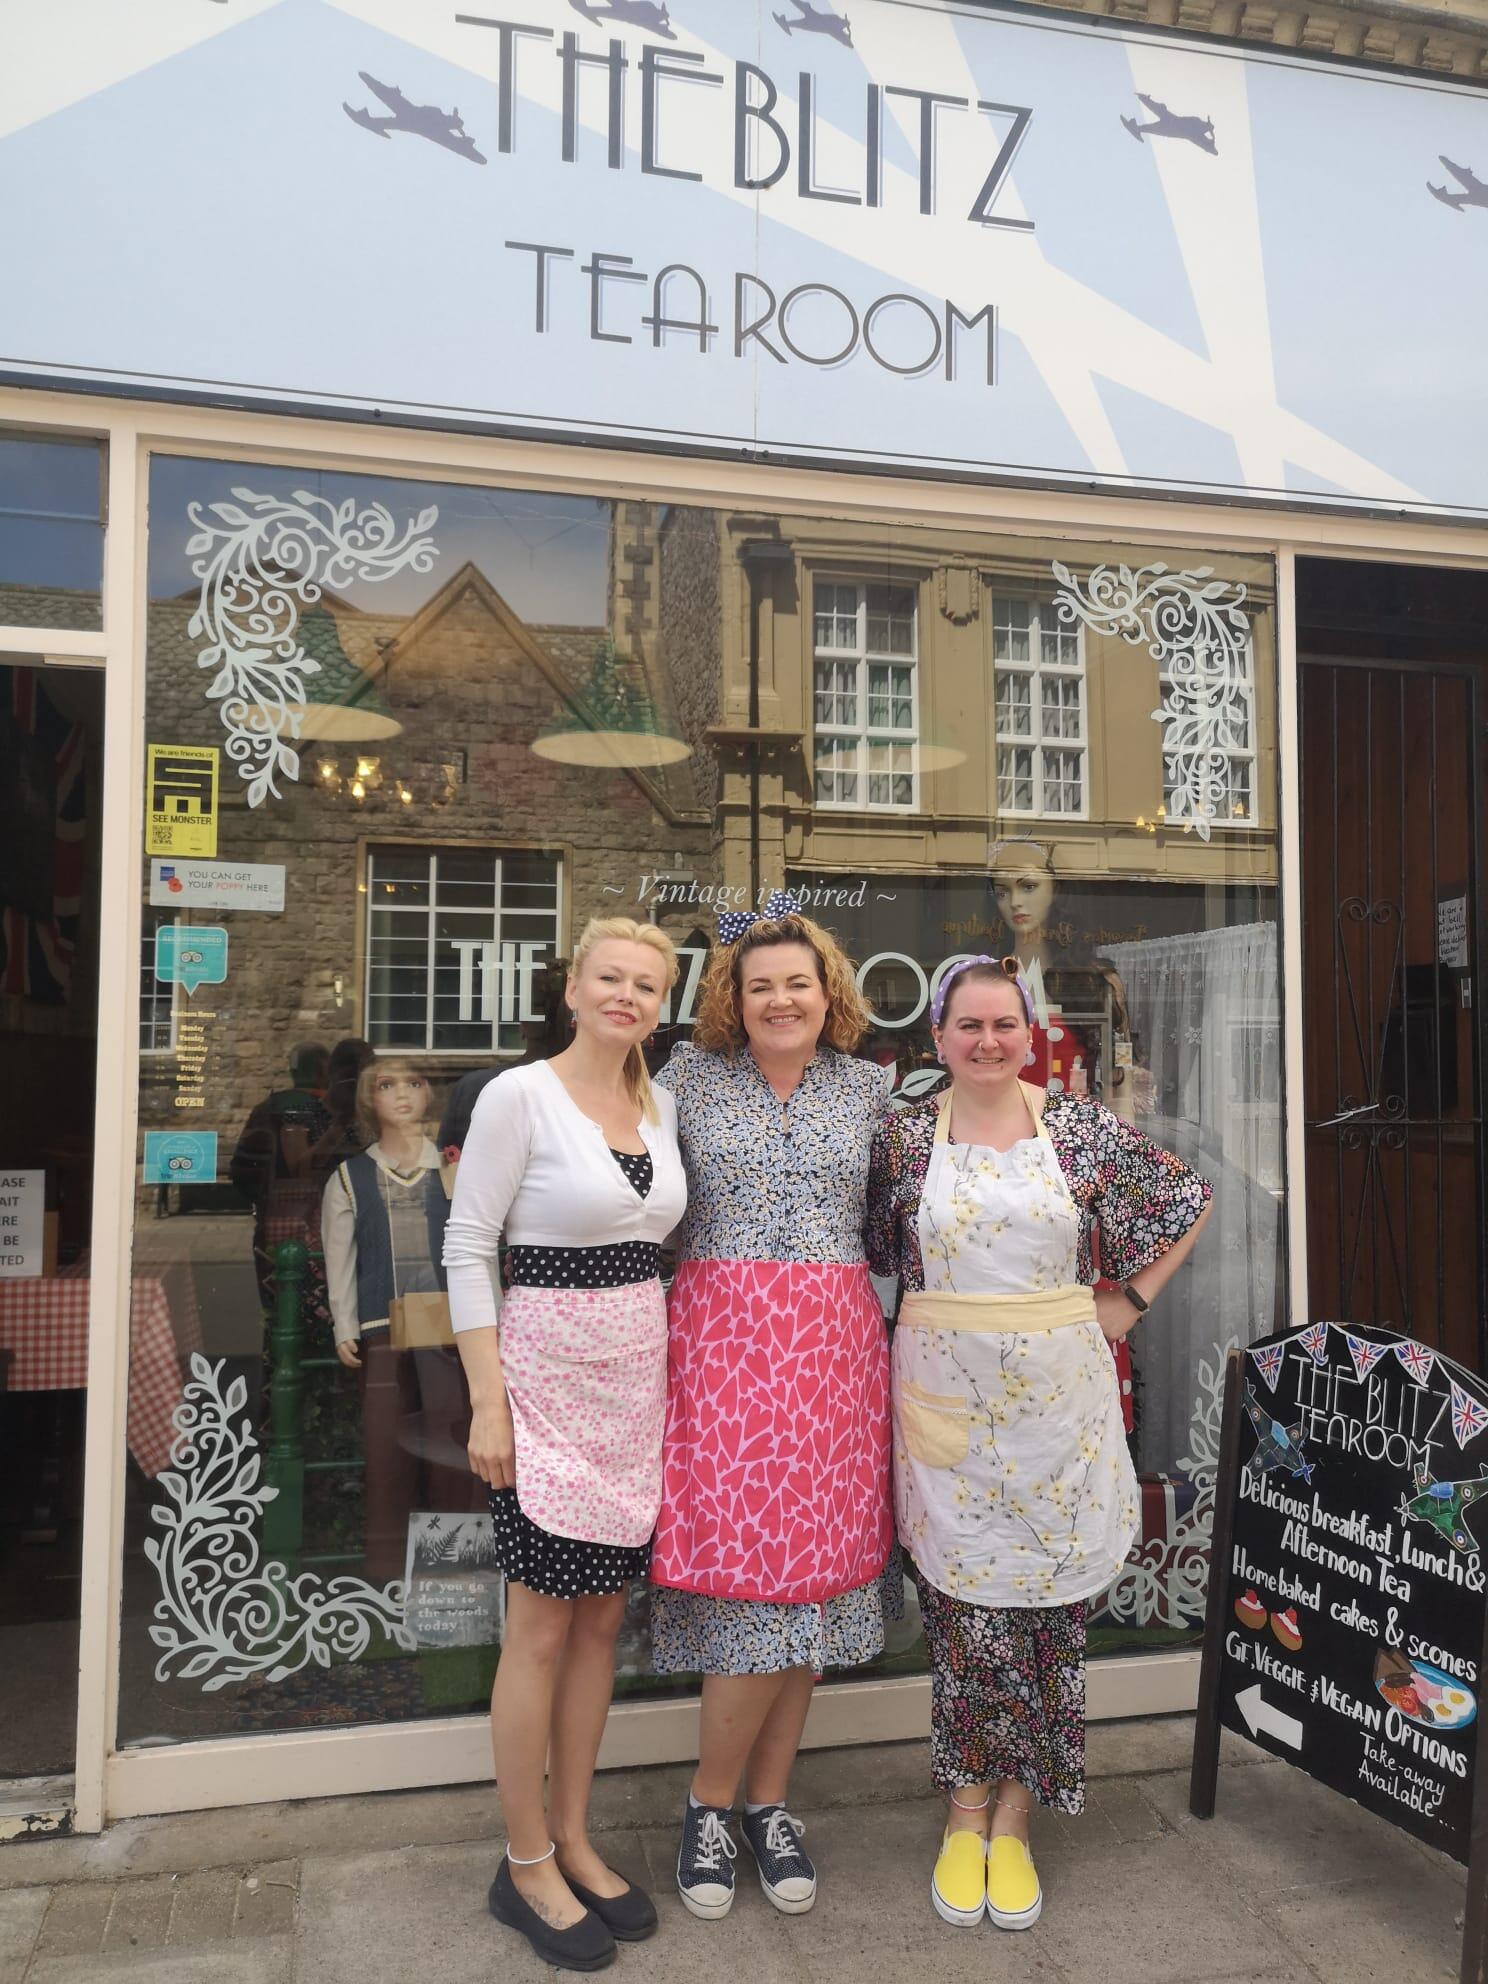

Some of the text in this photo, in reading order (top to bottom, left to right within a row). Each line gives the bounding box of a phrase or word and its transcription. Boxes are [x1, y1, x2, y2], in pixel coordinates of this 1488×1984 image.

[455, 13, 1036, 232] THE BLITZ
[152, 814, 212, 825] SEE MONSTER
[188, 870, 252, 881] YOU CAN GET
[188, 881, 269, 892] YOUR POPPY HERE
[635, 875, 747, 914] Vintage
[451, 941, 547, 1022] THE
[0, 1177, 26, 1188] ASE
[0, 1196, 20, 1207] AIT
[0, 1215, 19, 1226] RE
[3, 1235, 20, 1246] BE
[0, 1255, 25, 1266] TED
[1289, 1353, 1451, 1448] THE BLITZ
[1239, 1465, 1310, 1523] Delicious
[1402, 1530, 1464, 1586] Lunch
[1465, 1553, 1487, 1594] &
[1280, 1519, 1411, 1602] Afternoon Tea
[418, 1580, 485, 1593] If you go
[418, 1594, 476, 1605] down to
[418, 1605, 489, 1618] the woods
[1330, 1598, 1379, 1637] cakes
[1385, 1606, 1404, 1648] &
[1407, 1634, 1477, 1682] scones
[1320, 1675, 1381, 1732] VEGAN
[1385, 1707, 1468, 1778] OPTIONS
[1359, 1731, 1445, 1805] Take-away
